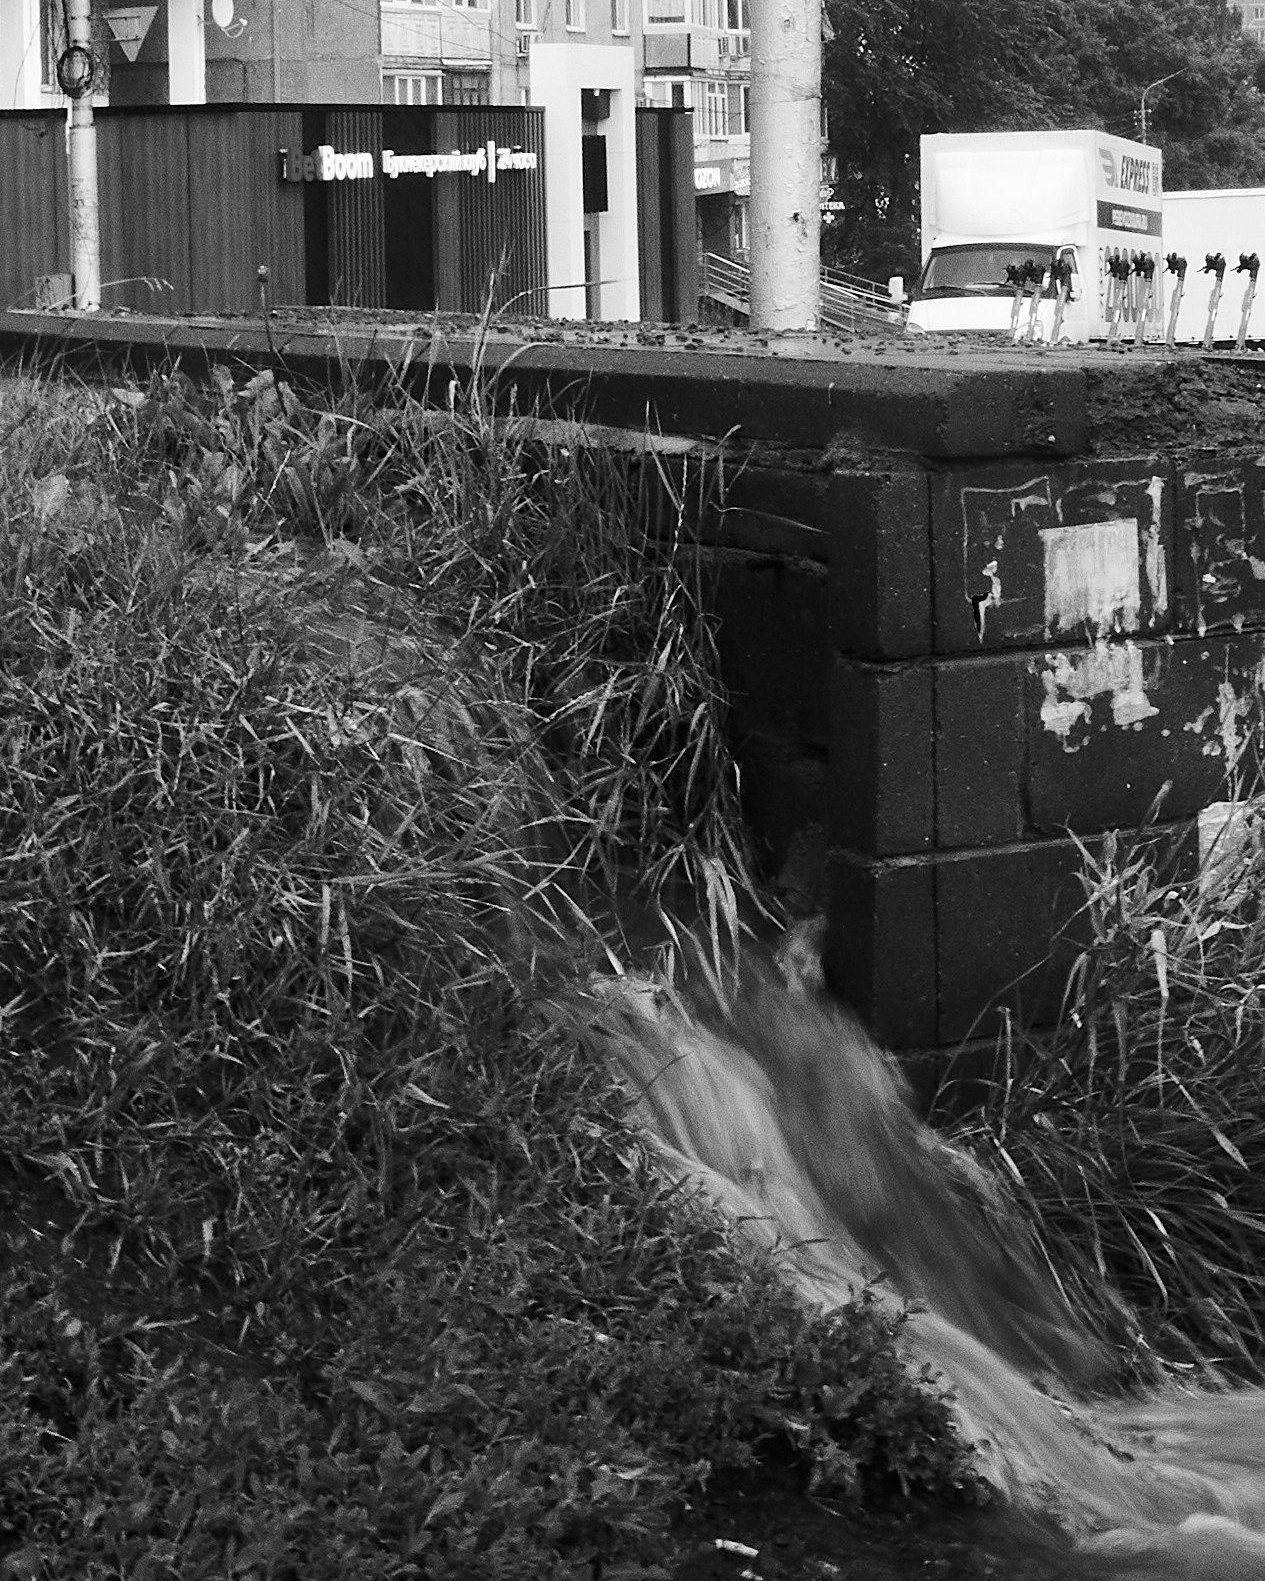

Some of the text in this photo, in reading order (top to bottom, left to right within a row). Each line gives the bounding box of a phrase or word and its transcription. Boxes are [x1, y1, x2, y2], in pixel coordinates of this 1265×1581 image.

[287, 145, 374, 182] BetBoom
[694, 167, 721, 190] OZON
[1120, 155, 1150, 194] EXPRESS
